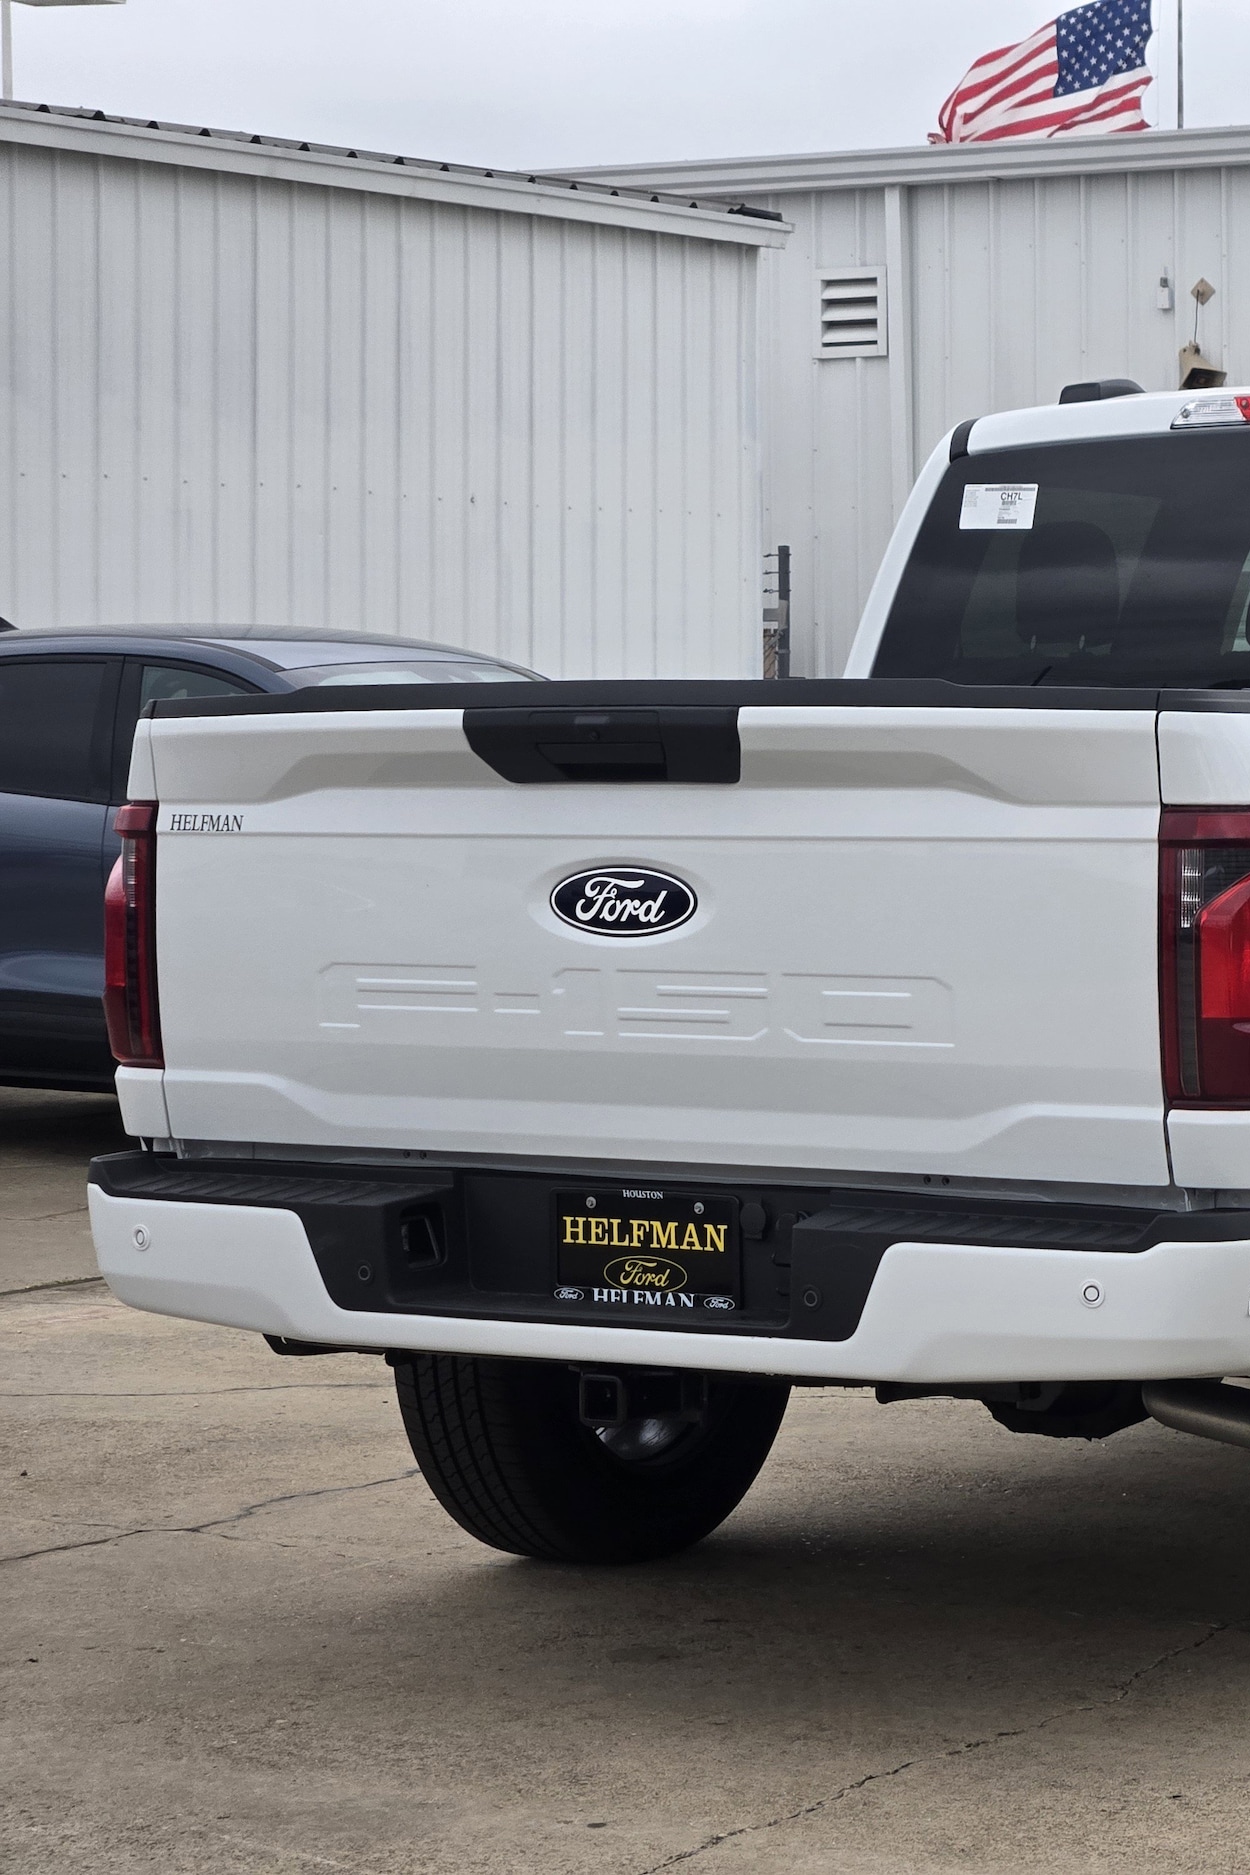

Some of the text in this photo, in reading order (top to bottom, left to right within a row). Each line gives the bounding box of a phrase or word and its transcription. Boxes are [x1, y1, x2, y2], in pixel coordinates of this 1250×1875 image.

[1000, 492, 1023, 501] CH7L
[169, 814, 244, 832] HELFMAN
[576, 876, 668, 923] Ford
[622, 1189, 664, 1199] HOUSTON
[562, 1216, 728, 1253] HELFMAN
[619, 1259, 671, 1287] Ford
